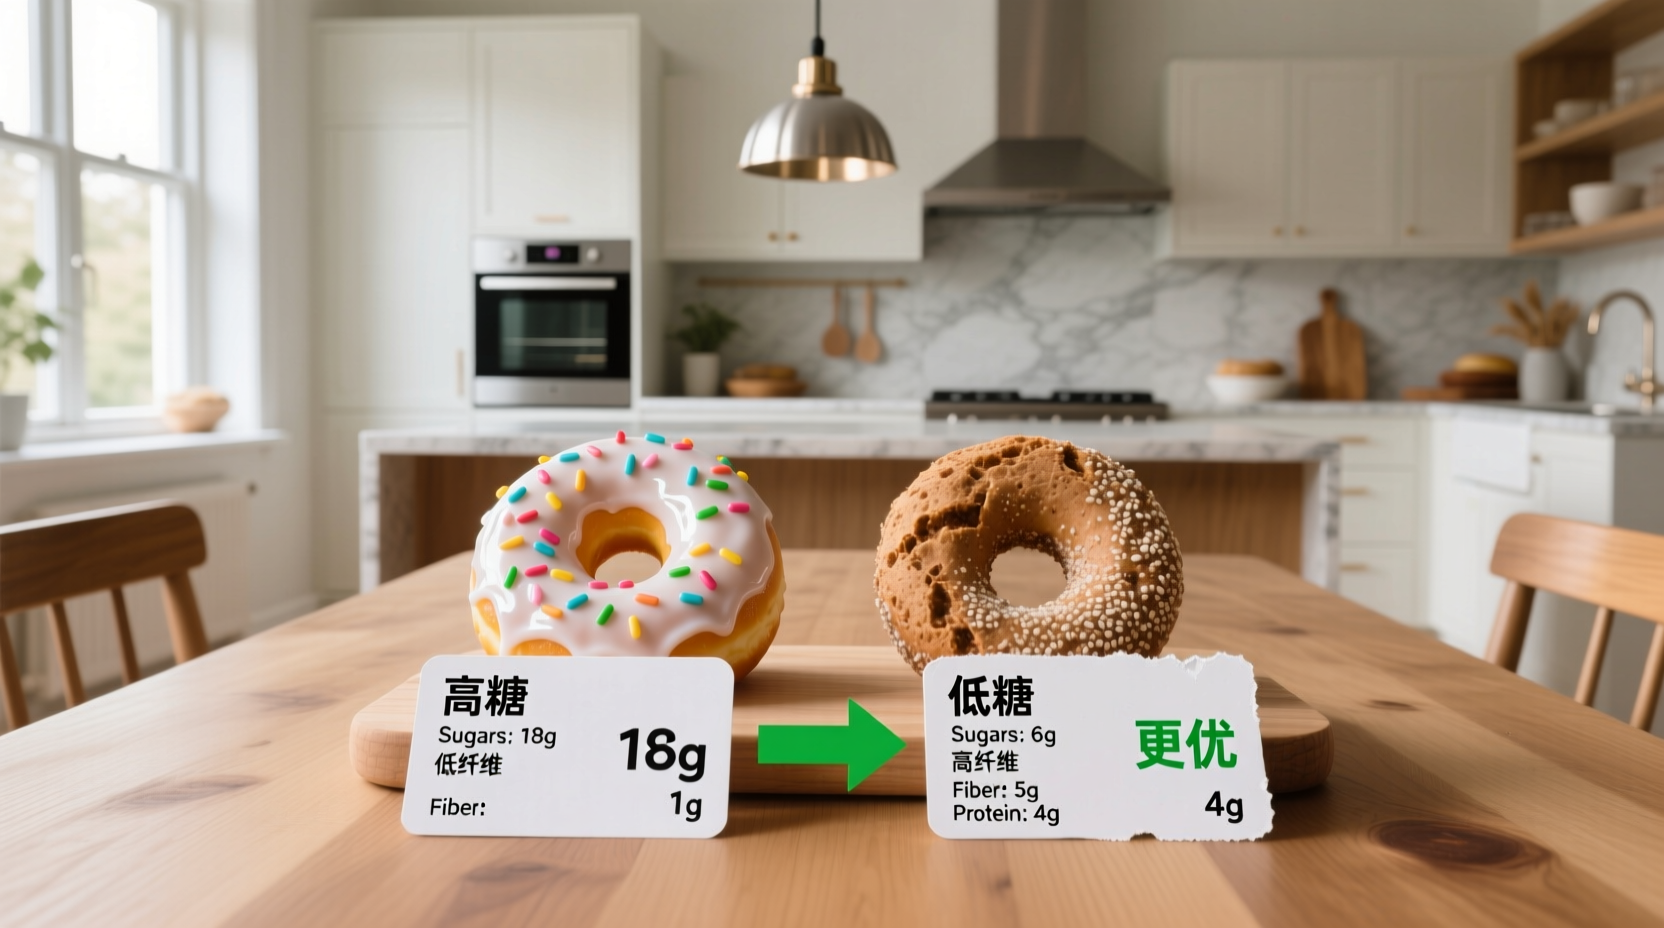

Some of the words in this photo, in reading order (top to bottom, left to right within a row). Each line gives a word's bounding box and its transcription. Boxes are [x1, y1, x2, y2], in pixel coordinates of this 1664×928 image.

[443, 674, 529, 717] 高糖
[947, 674, 1035, 717] 低糖
[521, 726, 557, 750] 18g
[951, 724, 1025, 748] Sugars:
[1031, 725, 1056, 748] 6g
[1134, 717, 1238, 770] 更优
[434, 752, 503, 777] 低纤维
[619, 727, 707, 783] 18g
[951, 749, 1019, 773] 高纤维
[953, 780, 1007, 799] Fiber:
[1014, 780, 1039, 803] 5g
[430, 797, 486, 817] Fiber:
[670, 790, 703, 823] 1g
[953, 804, 1028, 822] Protein:
[1033, 804, 1060, 827] 4g
[1204, 790, 1244, 825] 4g
